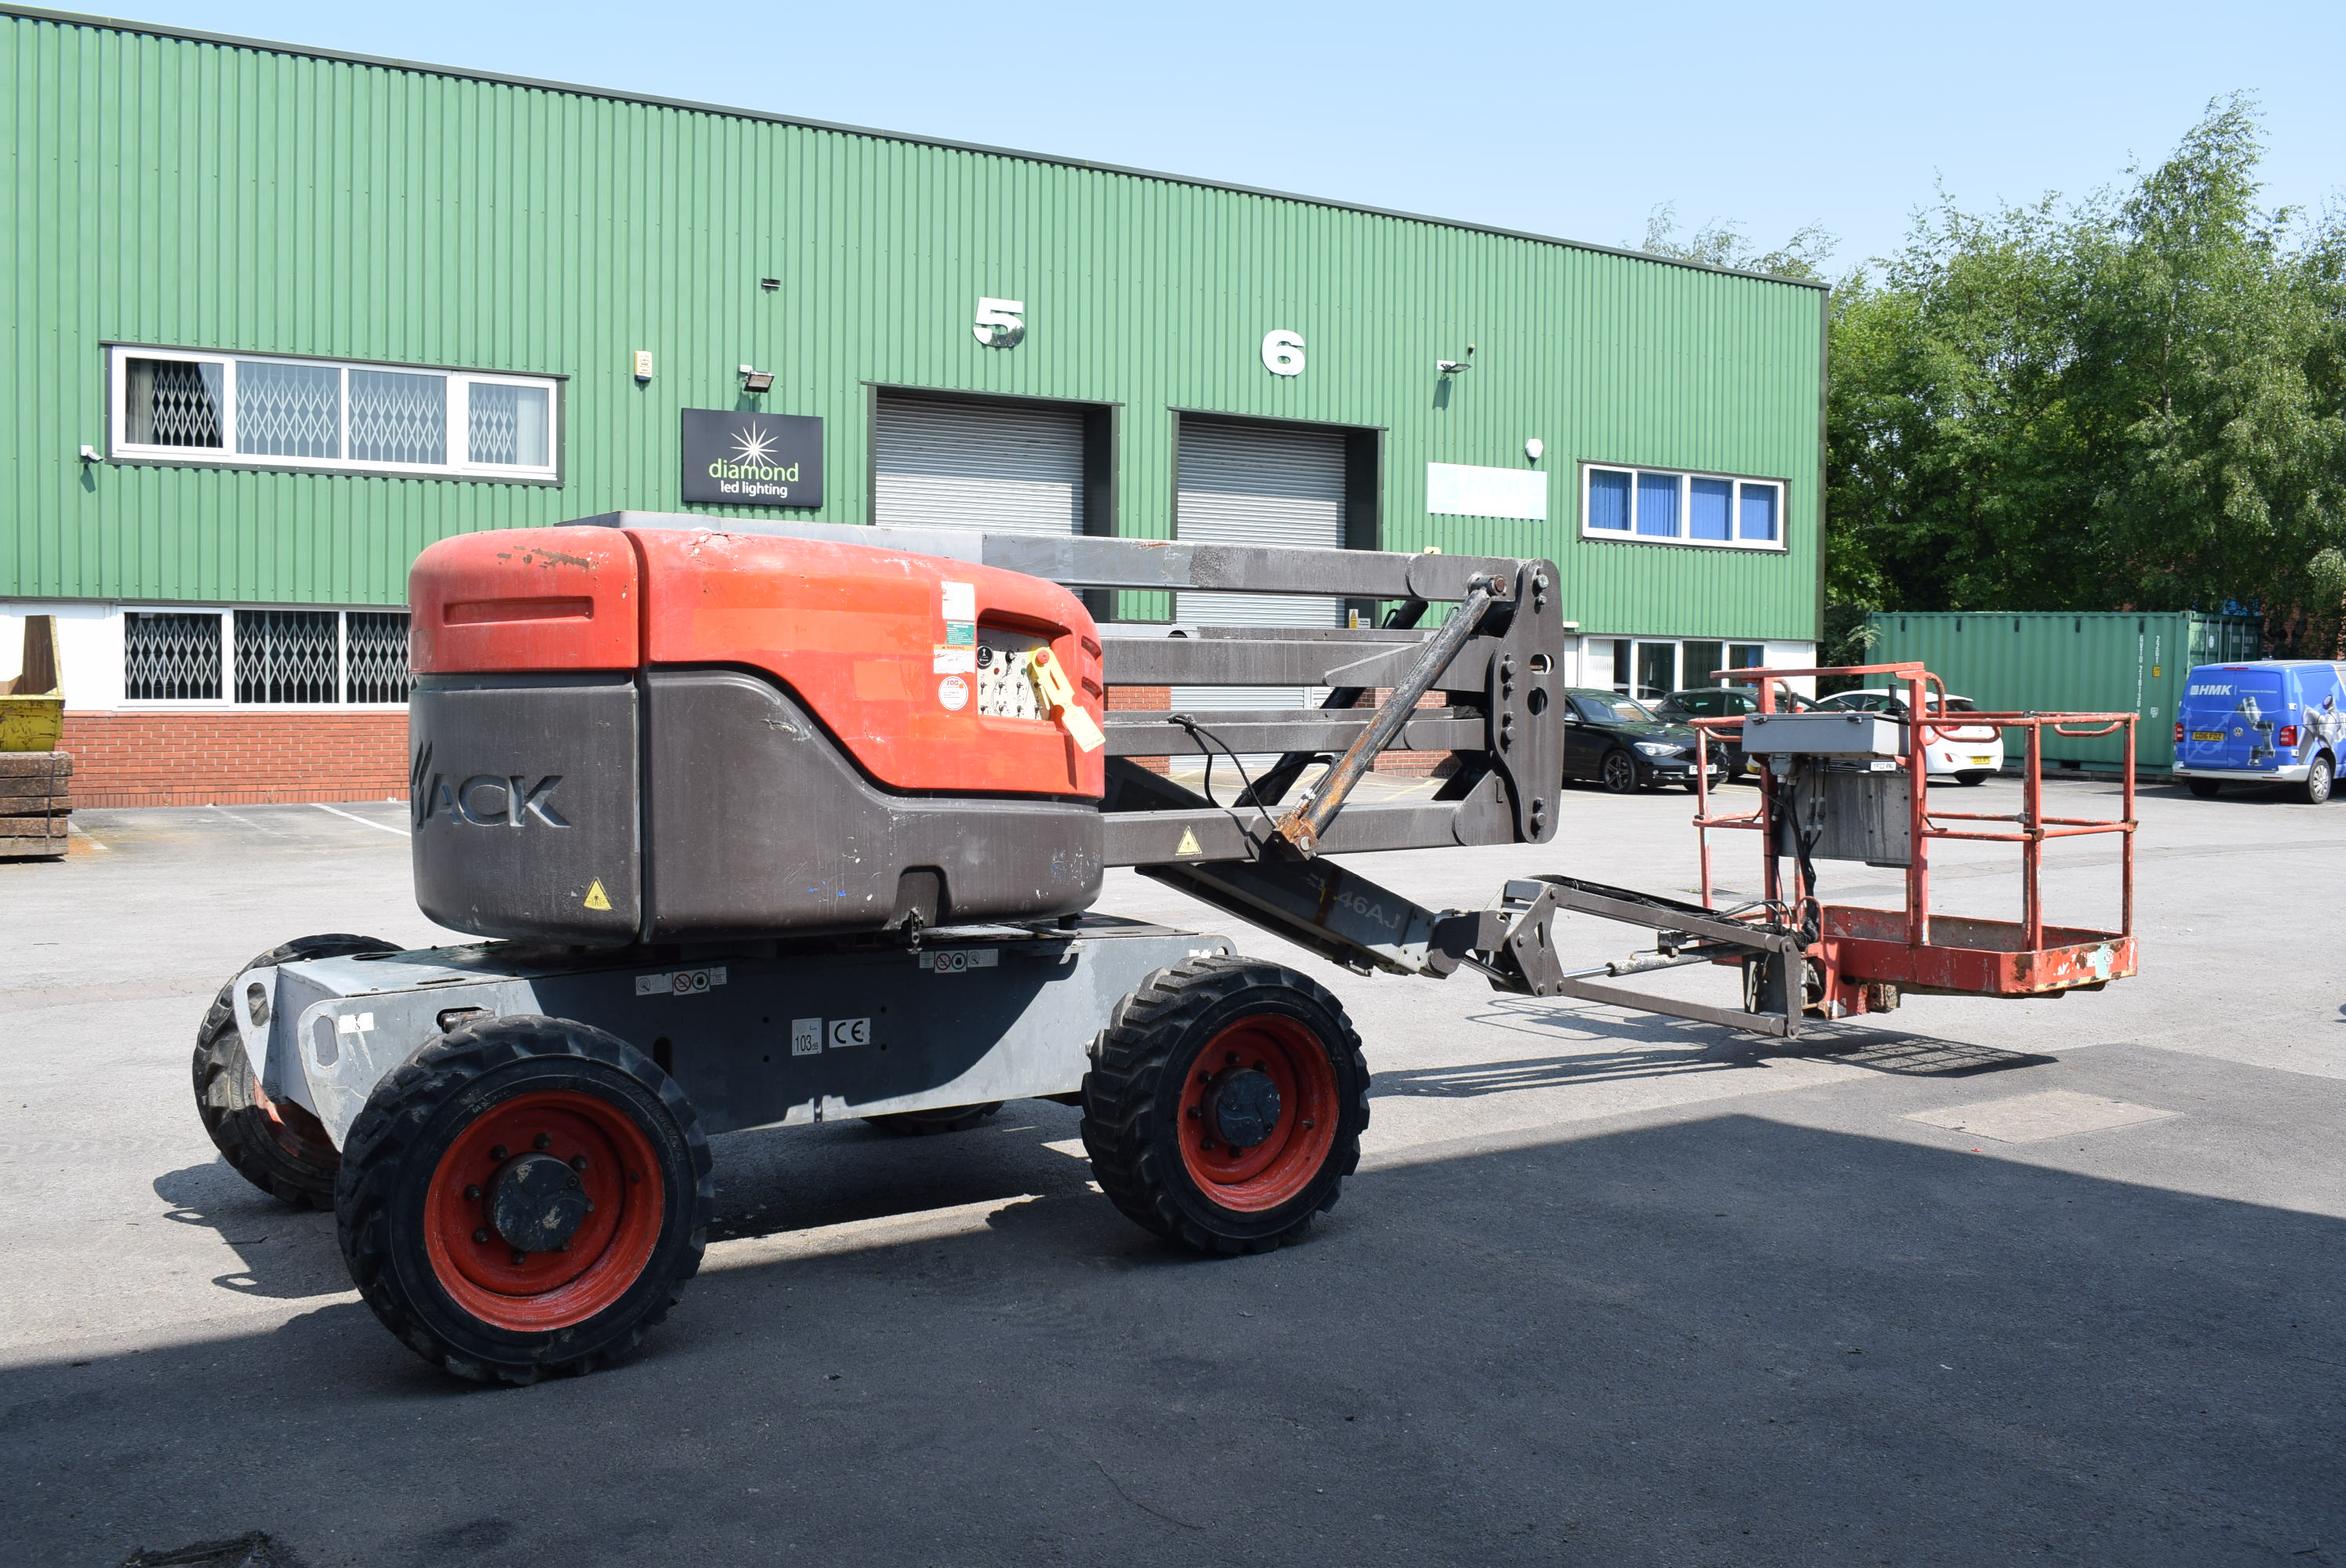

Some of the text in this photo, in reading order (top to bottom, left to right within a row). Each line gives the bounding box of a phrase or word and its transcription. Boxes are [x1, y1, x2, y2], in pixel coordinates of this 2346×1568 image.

[973, 296, 1025, 347] 5
[1261, 328, 1306, 376] 6
[709, 458, 799, 482] diamond
[721, 480, 788, 499] led lighting
[2199, 684, 2233, 695] HMK
[795, 1034, 812, 1052] 103
[834, 1020, 864, 1044] CE
